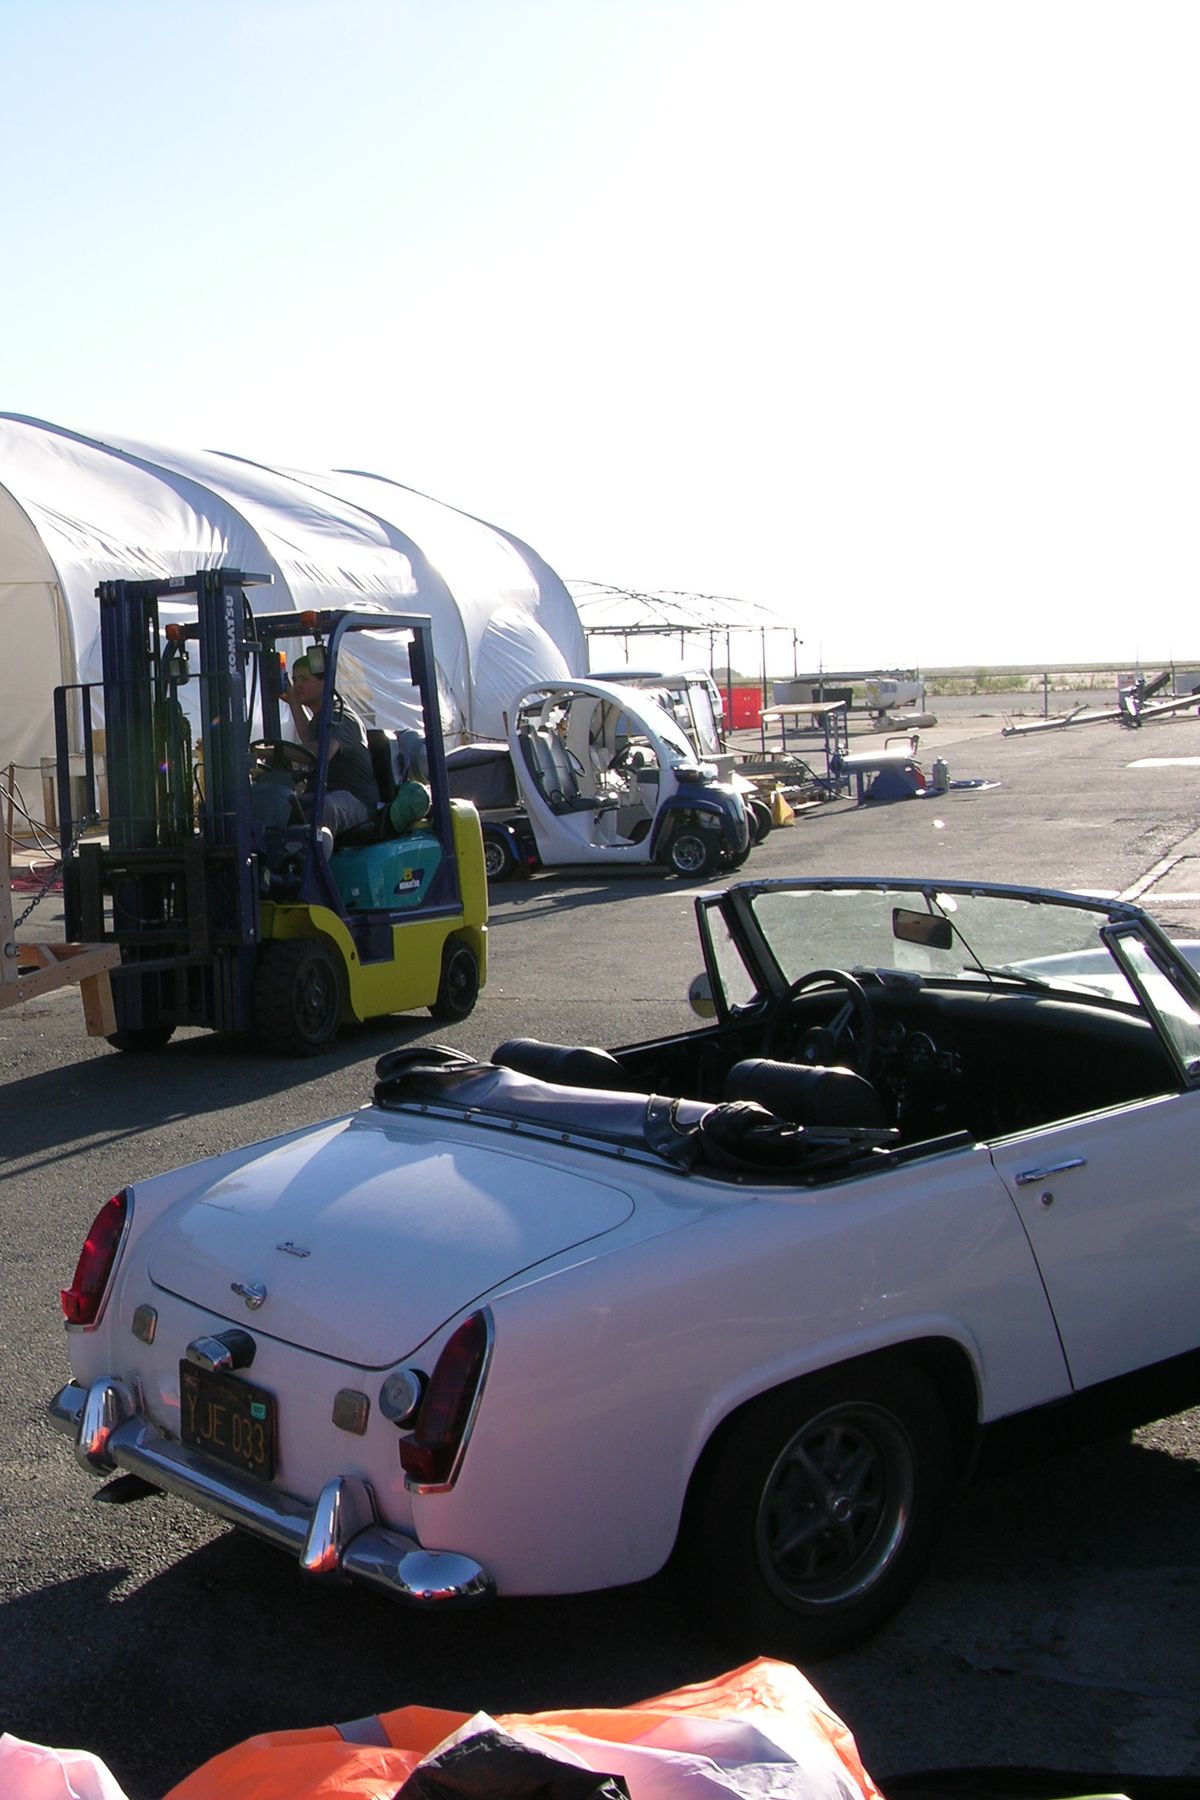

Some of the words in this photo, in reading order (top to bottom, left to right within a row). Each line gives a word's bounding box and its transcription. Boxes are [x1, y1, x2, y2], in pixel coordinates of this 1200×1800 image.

[225, 595, 237, 674] KOMATSU
[186, 1393, 226, 1447] YJE
[232, 1413, 265, 1465] 033
